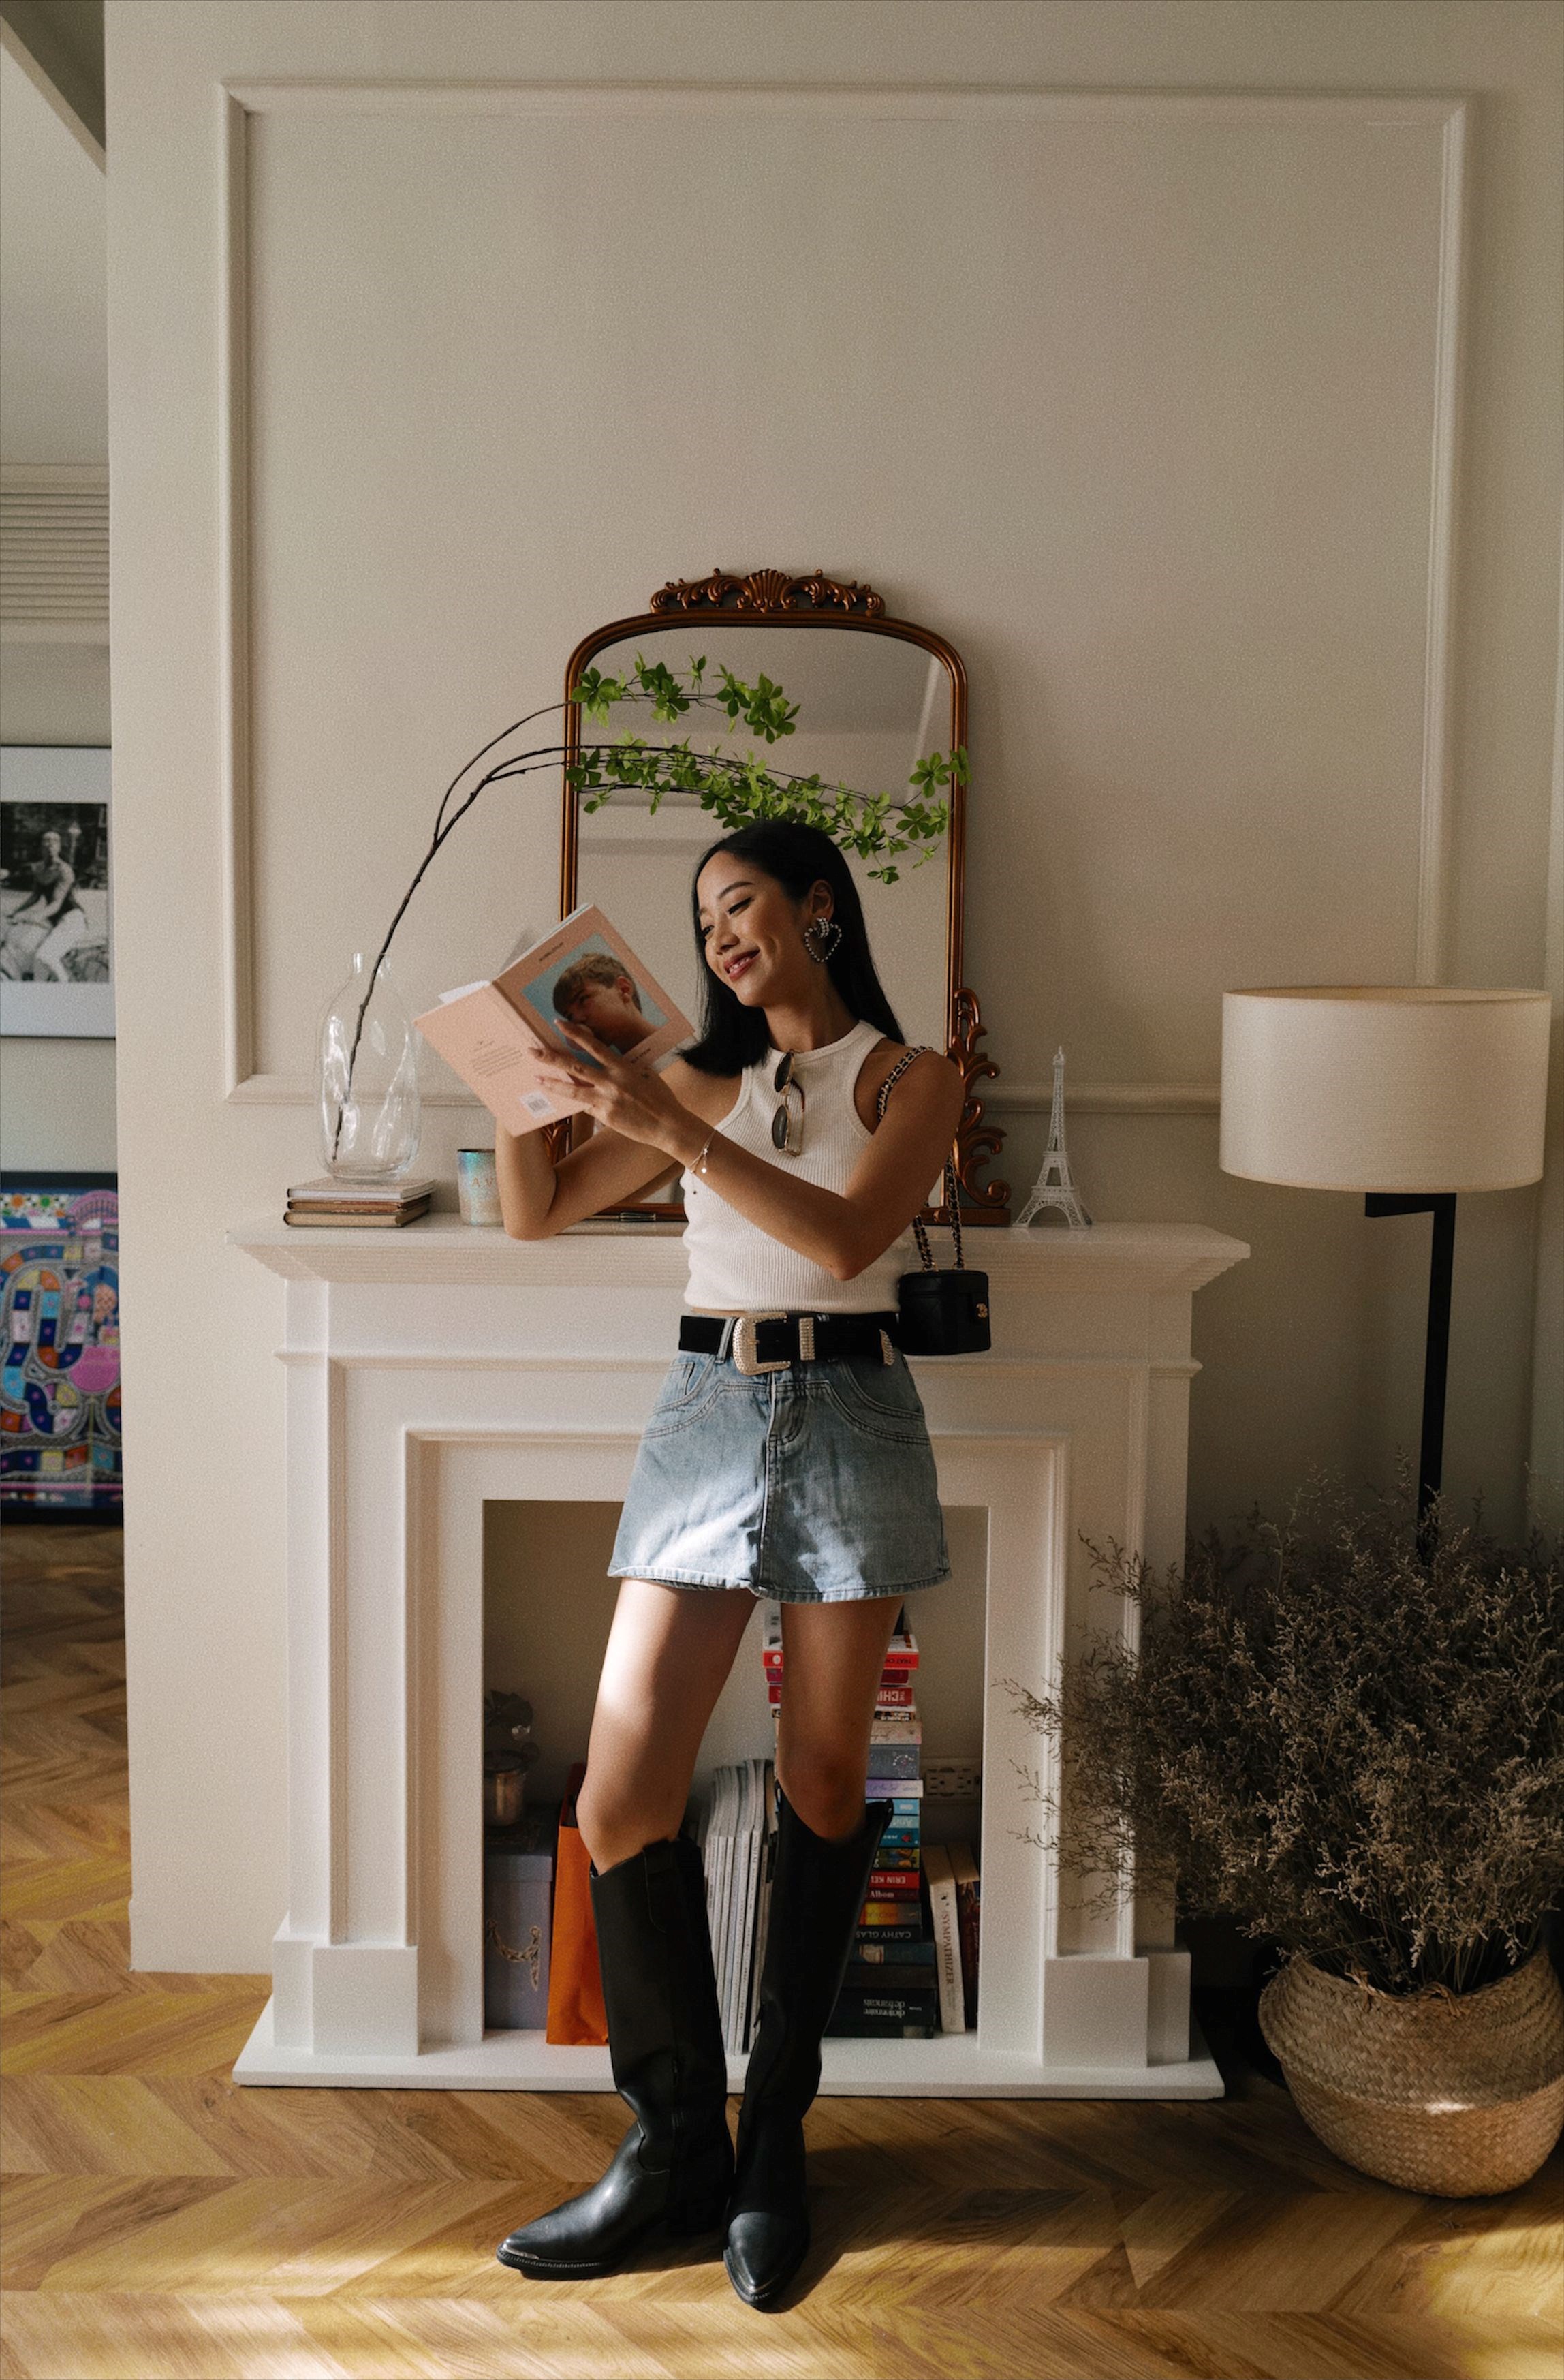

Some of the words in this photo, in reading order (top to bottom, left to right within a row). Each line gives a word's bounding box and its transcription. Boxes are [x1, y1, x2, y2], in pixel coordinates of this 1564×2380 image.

[877, 1690, 899, 1702] CHI
[886, 1876, 907, 1885] ERIN
[881, 1930, 912, 1939] CATHY
[941, 1913, 954, 1985] SYMPATHIZER
